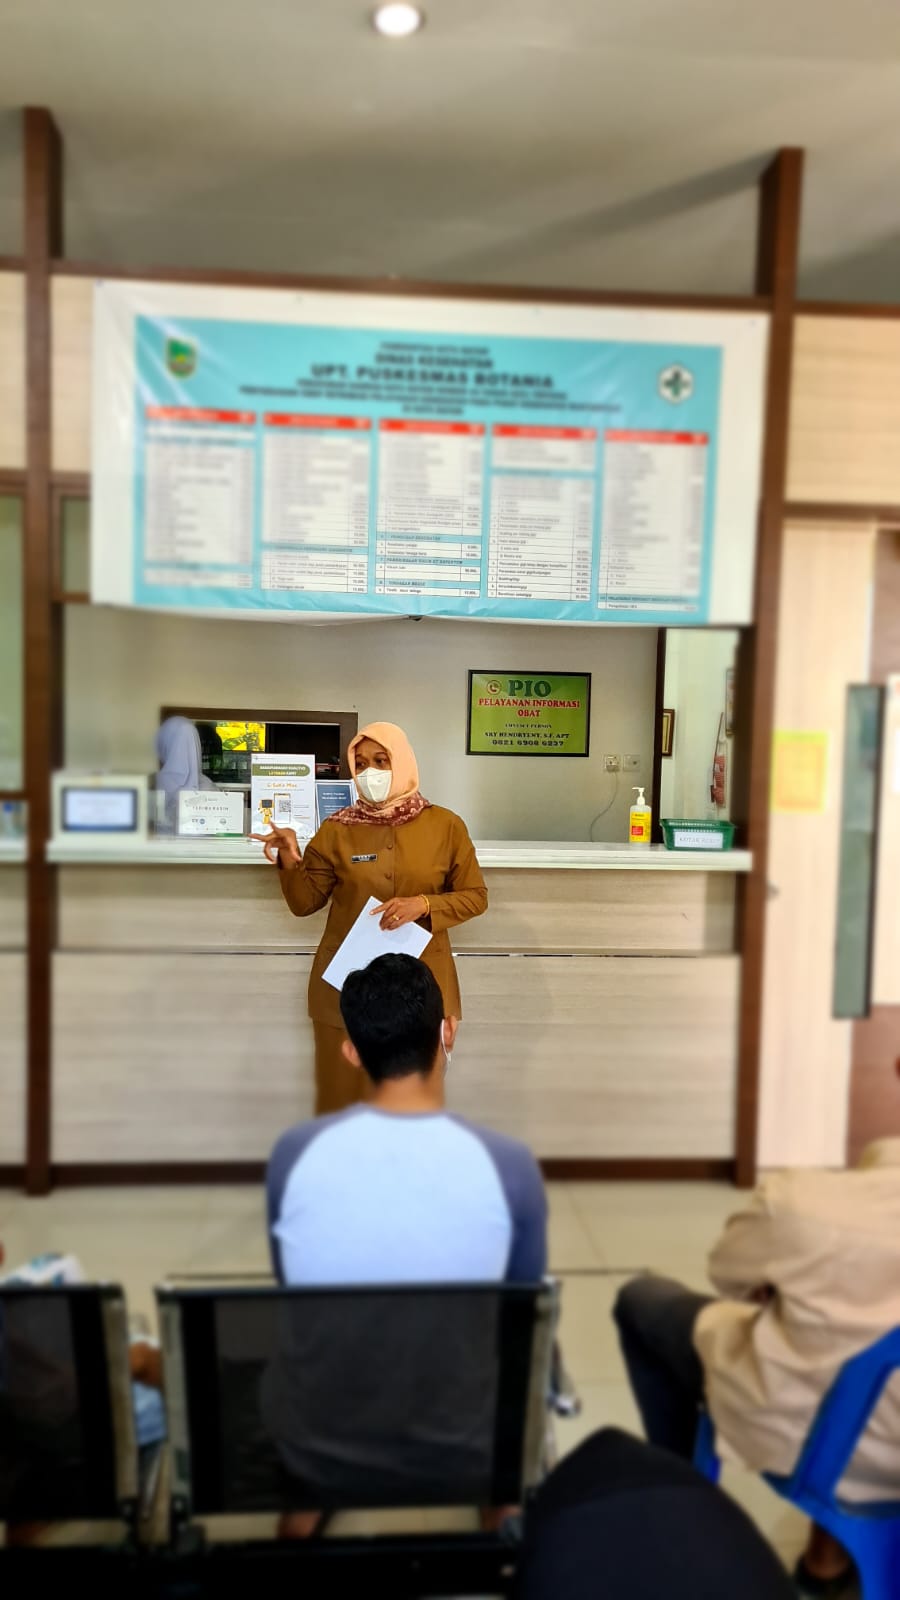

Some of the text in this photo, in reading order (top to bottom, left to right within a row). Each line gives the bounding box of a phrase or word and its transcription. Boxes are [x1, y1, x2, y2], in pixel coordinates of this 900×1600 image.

[356, 365, 469, 384] PUSKESMAS
[474, 373, 554, 388] BOTANIA
[508, 679, 552, 697] PIO
[479, 698, 580, 708] PELAYANAN INFORMASI
[517, 709, 541, 717] OBAT
